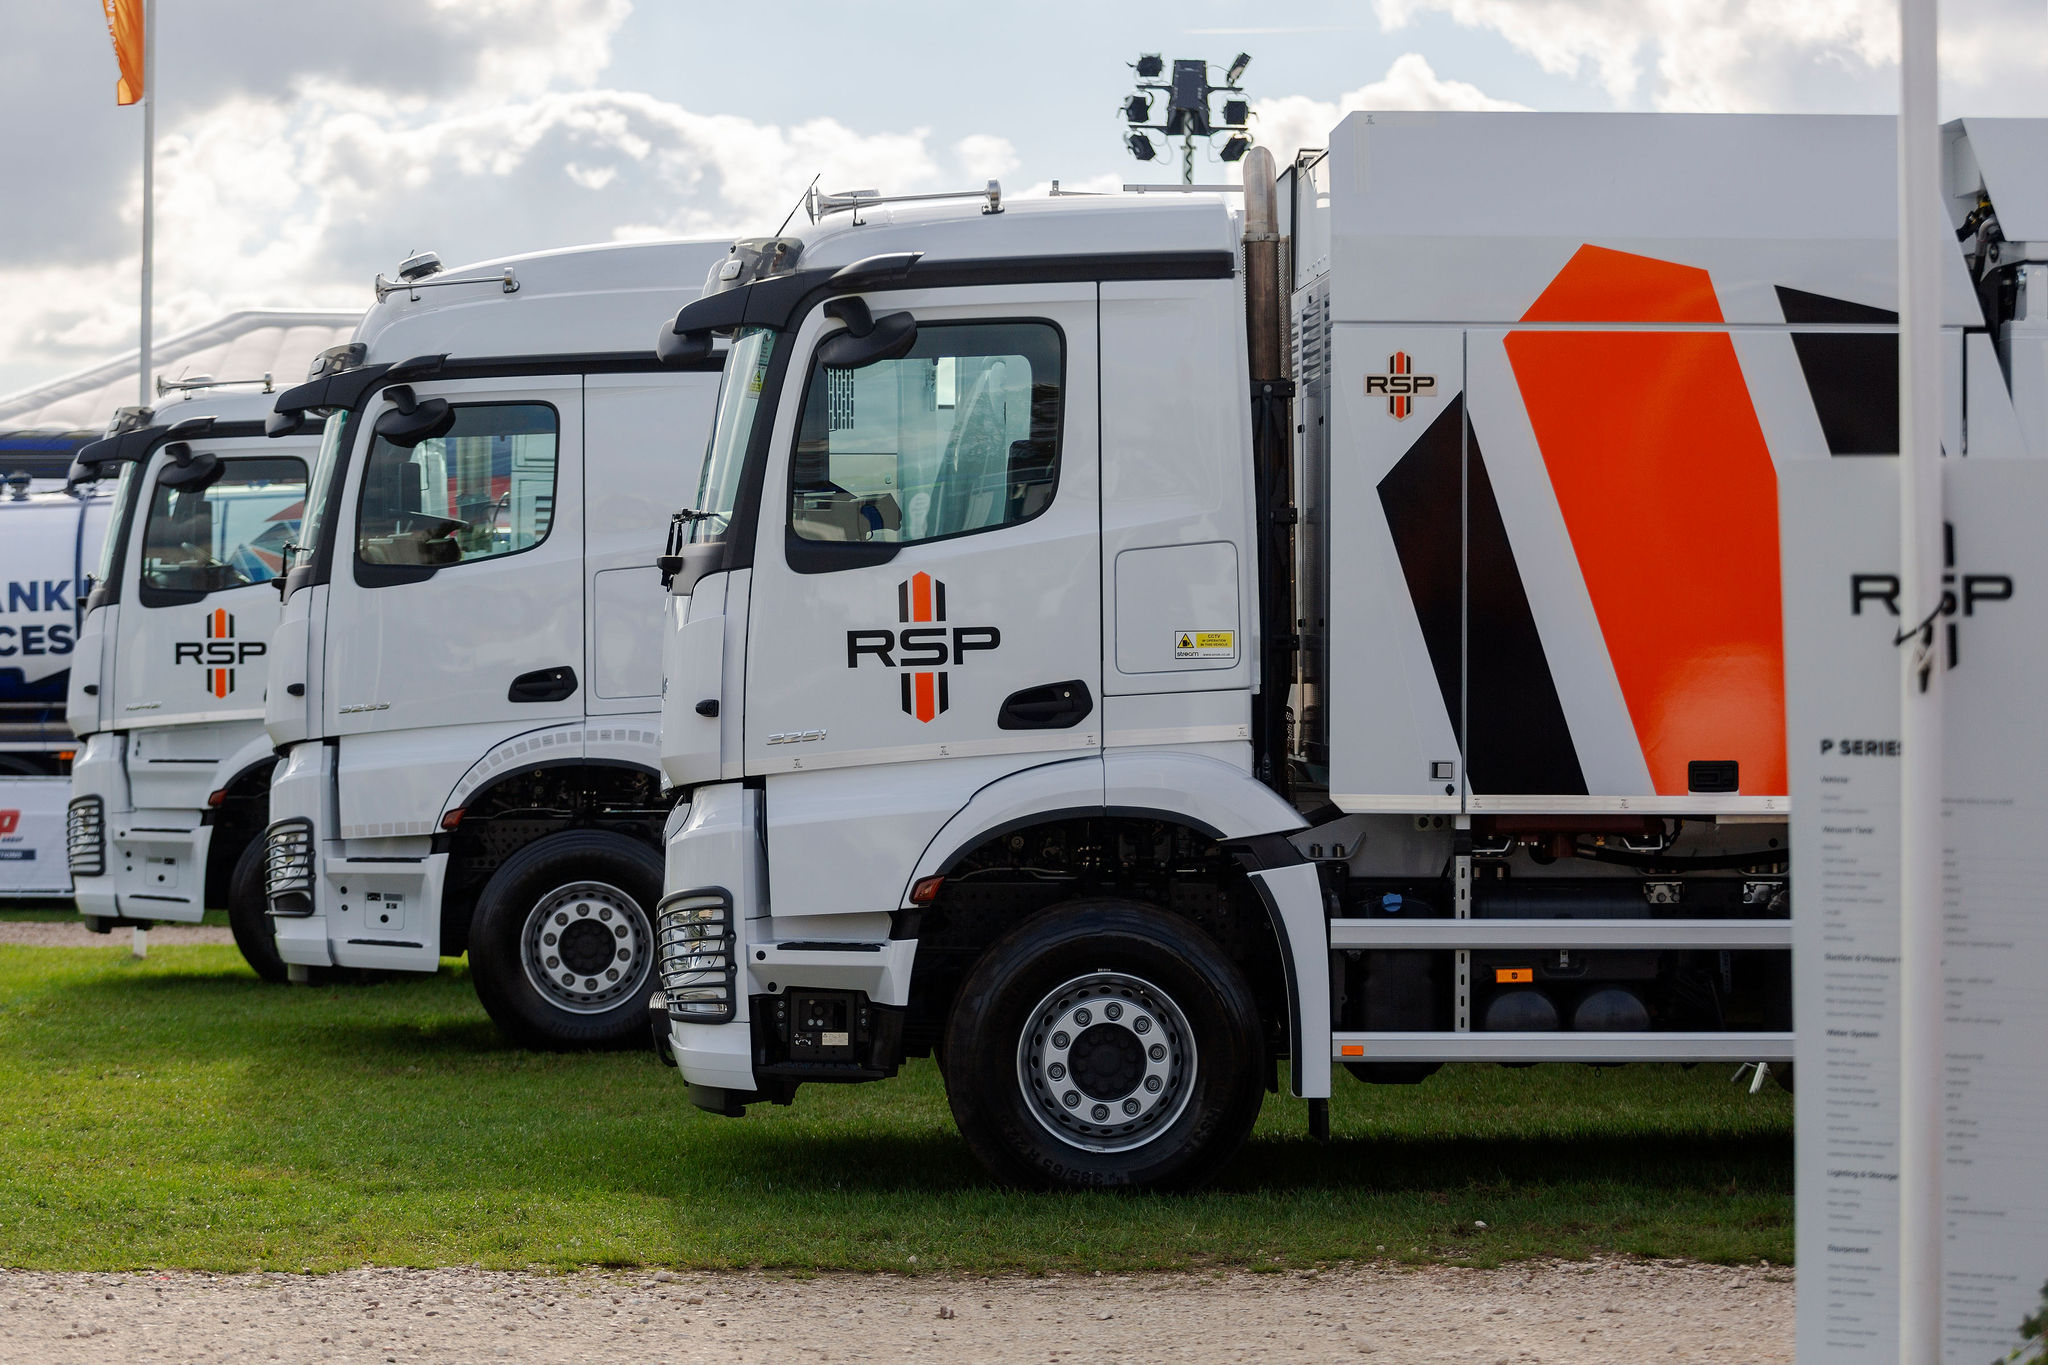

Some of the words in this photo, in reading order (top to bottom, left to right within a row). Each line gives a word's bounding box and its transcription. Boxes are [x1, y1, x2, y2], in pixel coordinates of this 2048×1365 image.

[1366, 376, 1435, 394] RSP
[175, 642, 267, 665] RSP
[847, 626, 1001, 669] RSP
[1820, 739, 1834, 755] P
